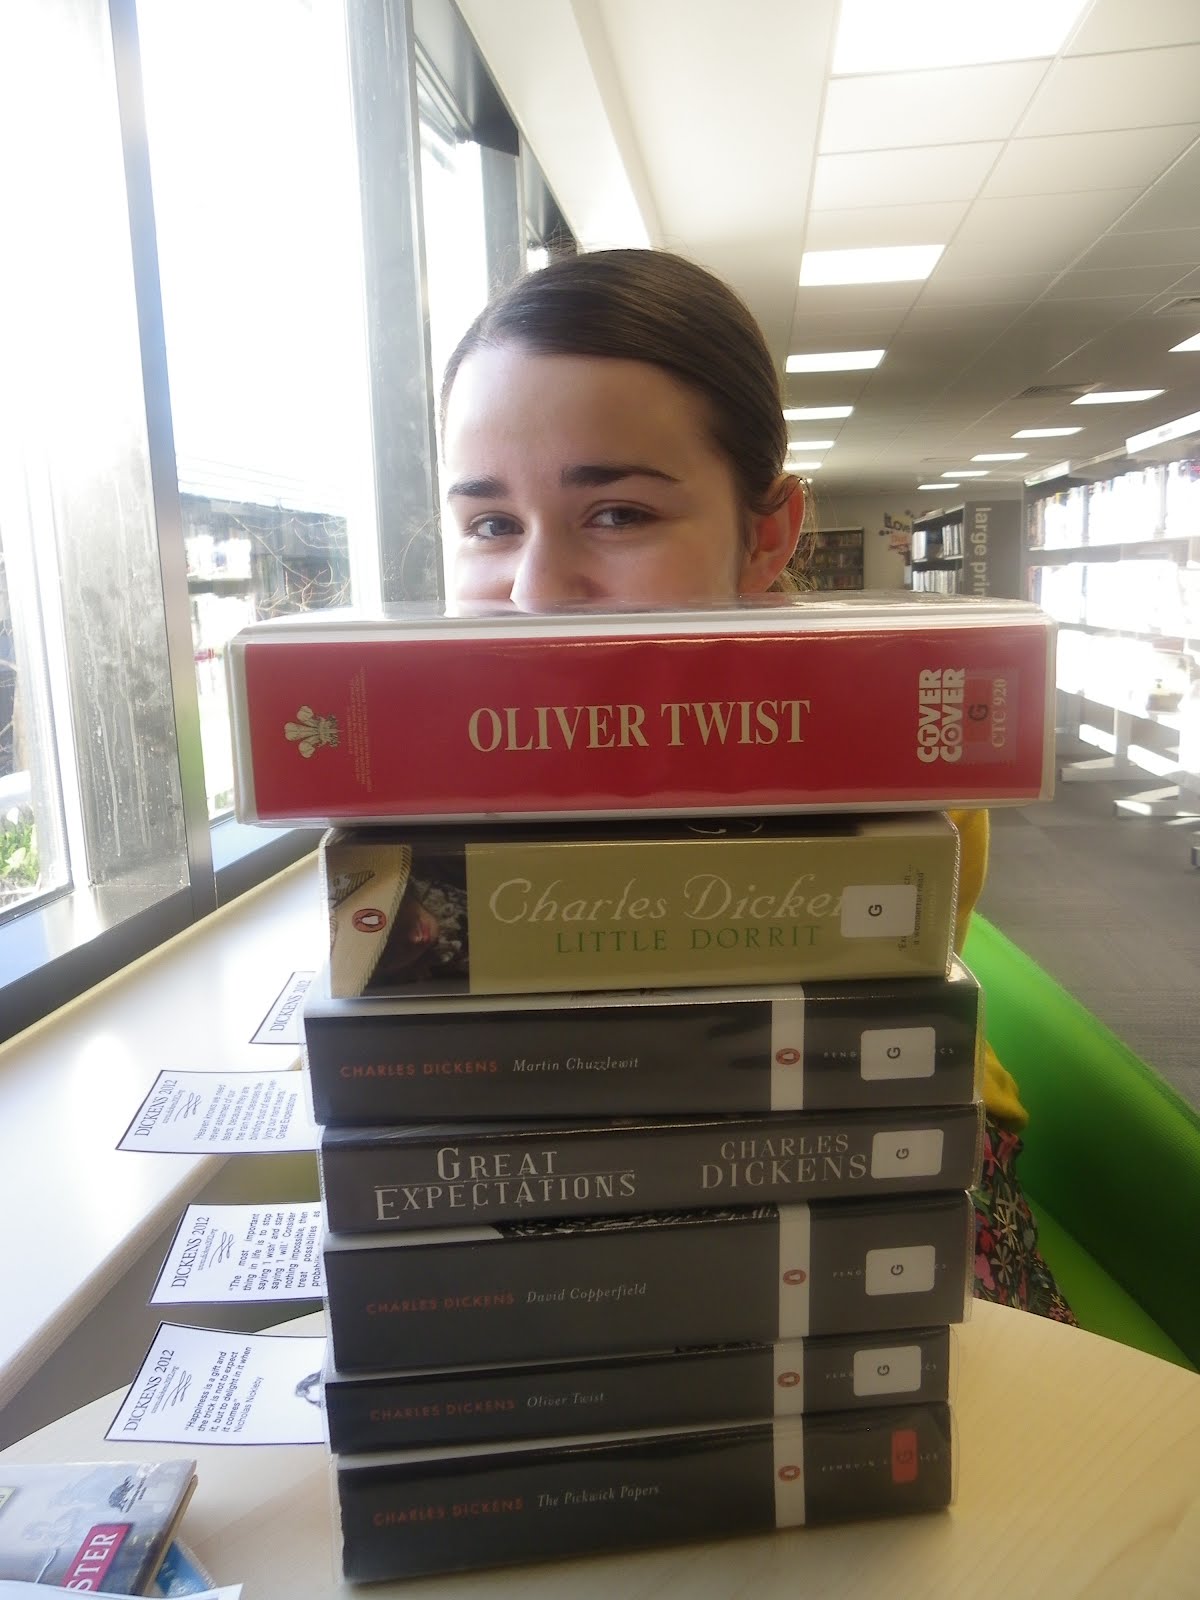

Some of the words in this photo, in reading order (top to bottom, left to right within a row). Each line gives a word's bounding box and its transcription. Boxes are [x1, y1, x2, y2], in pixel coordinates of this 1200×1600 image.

[970, 507, 992, 556] large
[992, 678, 1008, 706] 920
[467, 703, 649, 752] OLIVER
[660, 699, 811, 747] TWIST
[940, 668, 966, 763] COVER
[489, 878, 668, 924] Charles
[867, 904, 883, 918] G
[556, 929, 667, 954] LITTLE
[691, 925, 821, 950] DORRIT
[269, 995, 303, 1031] DICKENS
[293, 980, 312, 993] 2012
[886, 1046, 901, 1060] G
[339, 1063, 416, 1079] CHARLES
[423, 1060, 498, 1075] DICKENS
[512, 1058, 559, 1073] Martin
[565, 1055, 640, 1073] Chuzzlewit
[134, 1096, 169, 1136] DICKENS
[158, 1079, 178, 1095] 2012
[720, 1133, 850, 1161] CHARLES
[895, 1147, 910, 1160] G
[436, 1147, 558, 1181] GREAT
[701, 1153, 867, 1190] DICKENS
[374, 1173, 636, 1221] EXPECTATIONS
[274, 1212, 285, 1226] start
[271, 1228, 280, 1240] and
[170, 1238, 202, 1288] DICKENS
[191, 1216, 210, 1236] 2012
[238, 1250, 249, 1267] most
[243, 1273, 258, 1291] thing
[262, 1213, 273, 1226] stop
[271, 1267, 285, 1290] saying
[282, 1212, 296, 1238] Consider
[285, 1263, 299, 1289] nothing
[298, 1211, 308, 1224] then
[257, 1268, 272, 1291] saying
[297, 1271, 308, 1288] treat
[890, 1264, 904, 1276] G
[366, 1299, 437, 1315] CHARLES
[444, 1293, 515, 1309] DICKENS
[526, 1287, 565, 1303] David
[570, 1283, 647, 1301] Copperfield
[211, 1365, 221, 1377] gift
[216, 1351, 227, 1365] and
[224, 1351, 239, 1374] expect
[240, 1346, 252, 1364] when
[219, 1374, 229, 1382] to
[232, 1370, 242, 1378] in
[877, 1364, 890, 1376] G
[122, 1376, 162, 1432] DICKENS
[154, 1349, 175, 1373] 2012
[215, 1382, 226, 1394] not
[223, 1378, 239, 1402] delight
[203, 1402, 216, 1419] trick
[213, 1411, 225, 1424] but
[219, 1402, 228, 1410] to
[232, 1403, 252, 1433] Nicholas
[245, 1376, 264, 1403] Nickleby
[370, 1404, 441, 1421] CHARLES
[447, 1400, 515, 1416] DICKENS
[526, 1394, 567, 1409] Oliver
[572, 1392, 605, 1405] Twist
[197, 1419, 209, 1432] the
[372, 1510, 445, 1527] CHARLES
[452, 1498, 524, 1518] DICKENS
[538, 1494, 560, 1508] The
[564, 1487, 615, 1506] Pickwick
[620, 1484, 661, 1501] Papers
